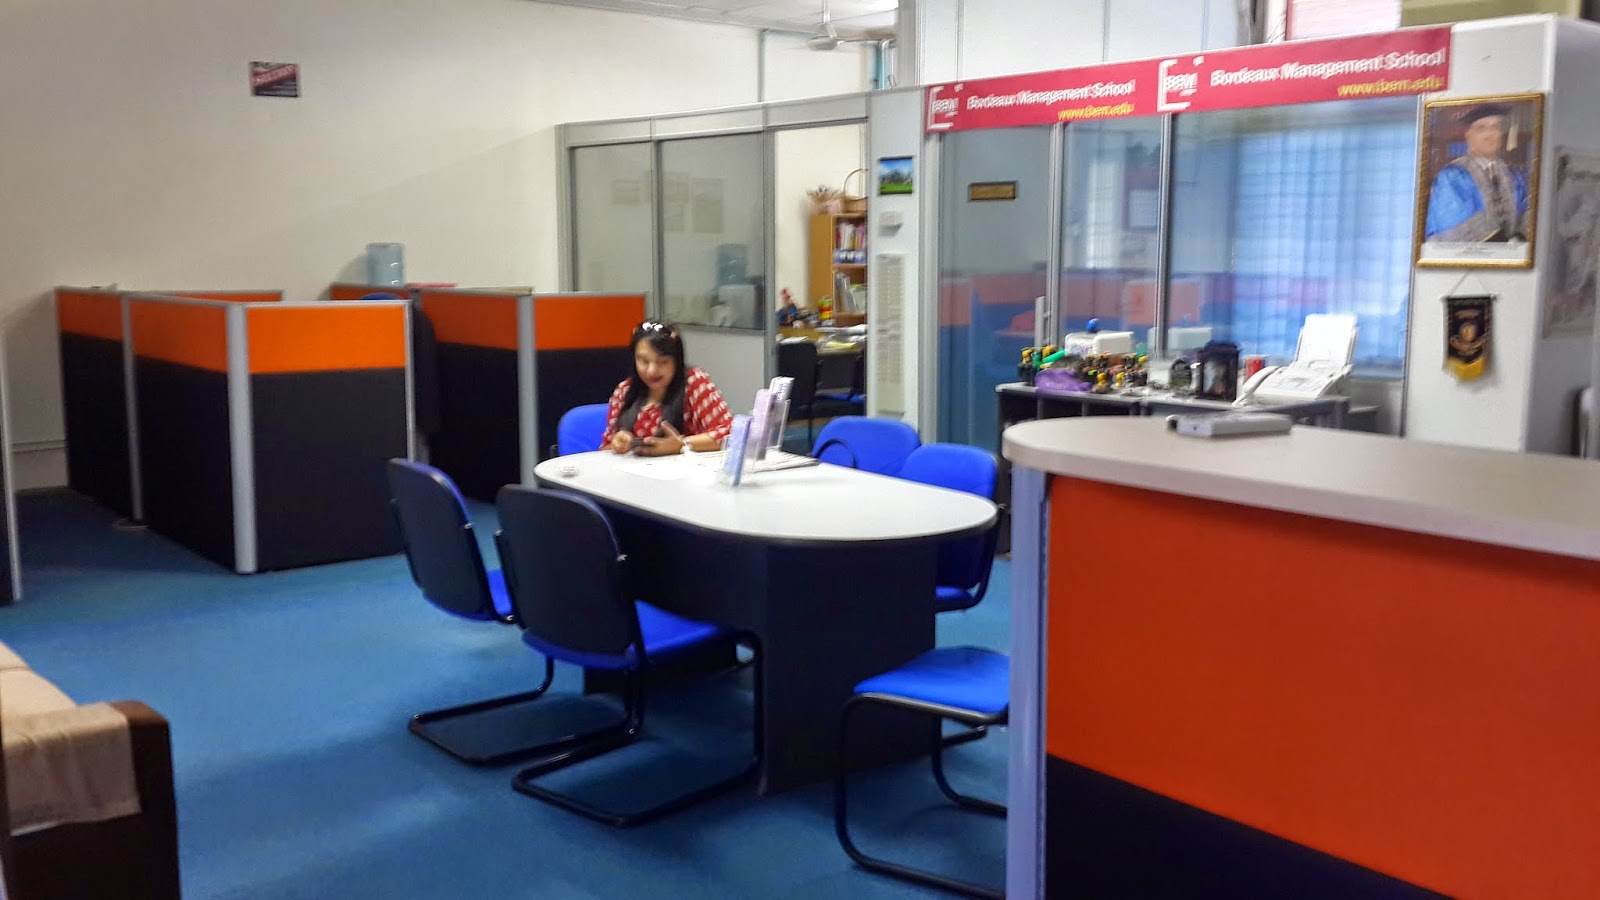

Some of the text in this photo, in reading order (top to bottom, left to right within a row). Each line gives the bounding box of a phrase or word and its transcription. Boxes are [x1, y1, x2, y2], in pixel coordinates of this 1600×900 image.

[1210, 47, 1446, 86] Bordeaux Management School
[967, 79, 1136, 110] Bordeaux Management School
